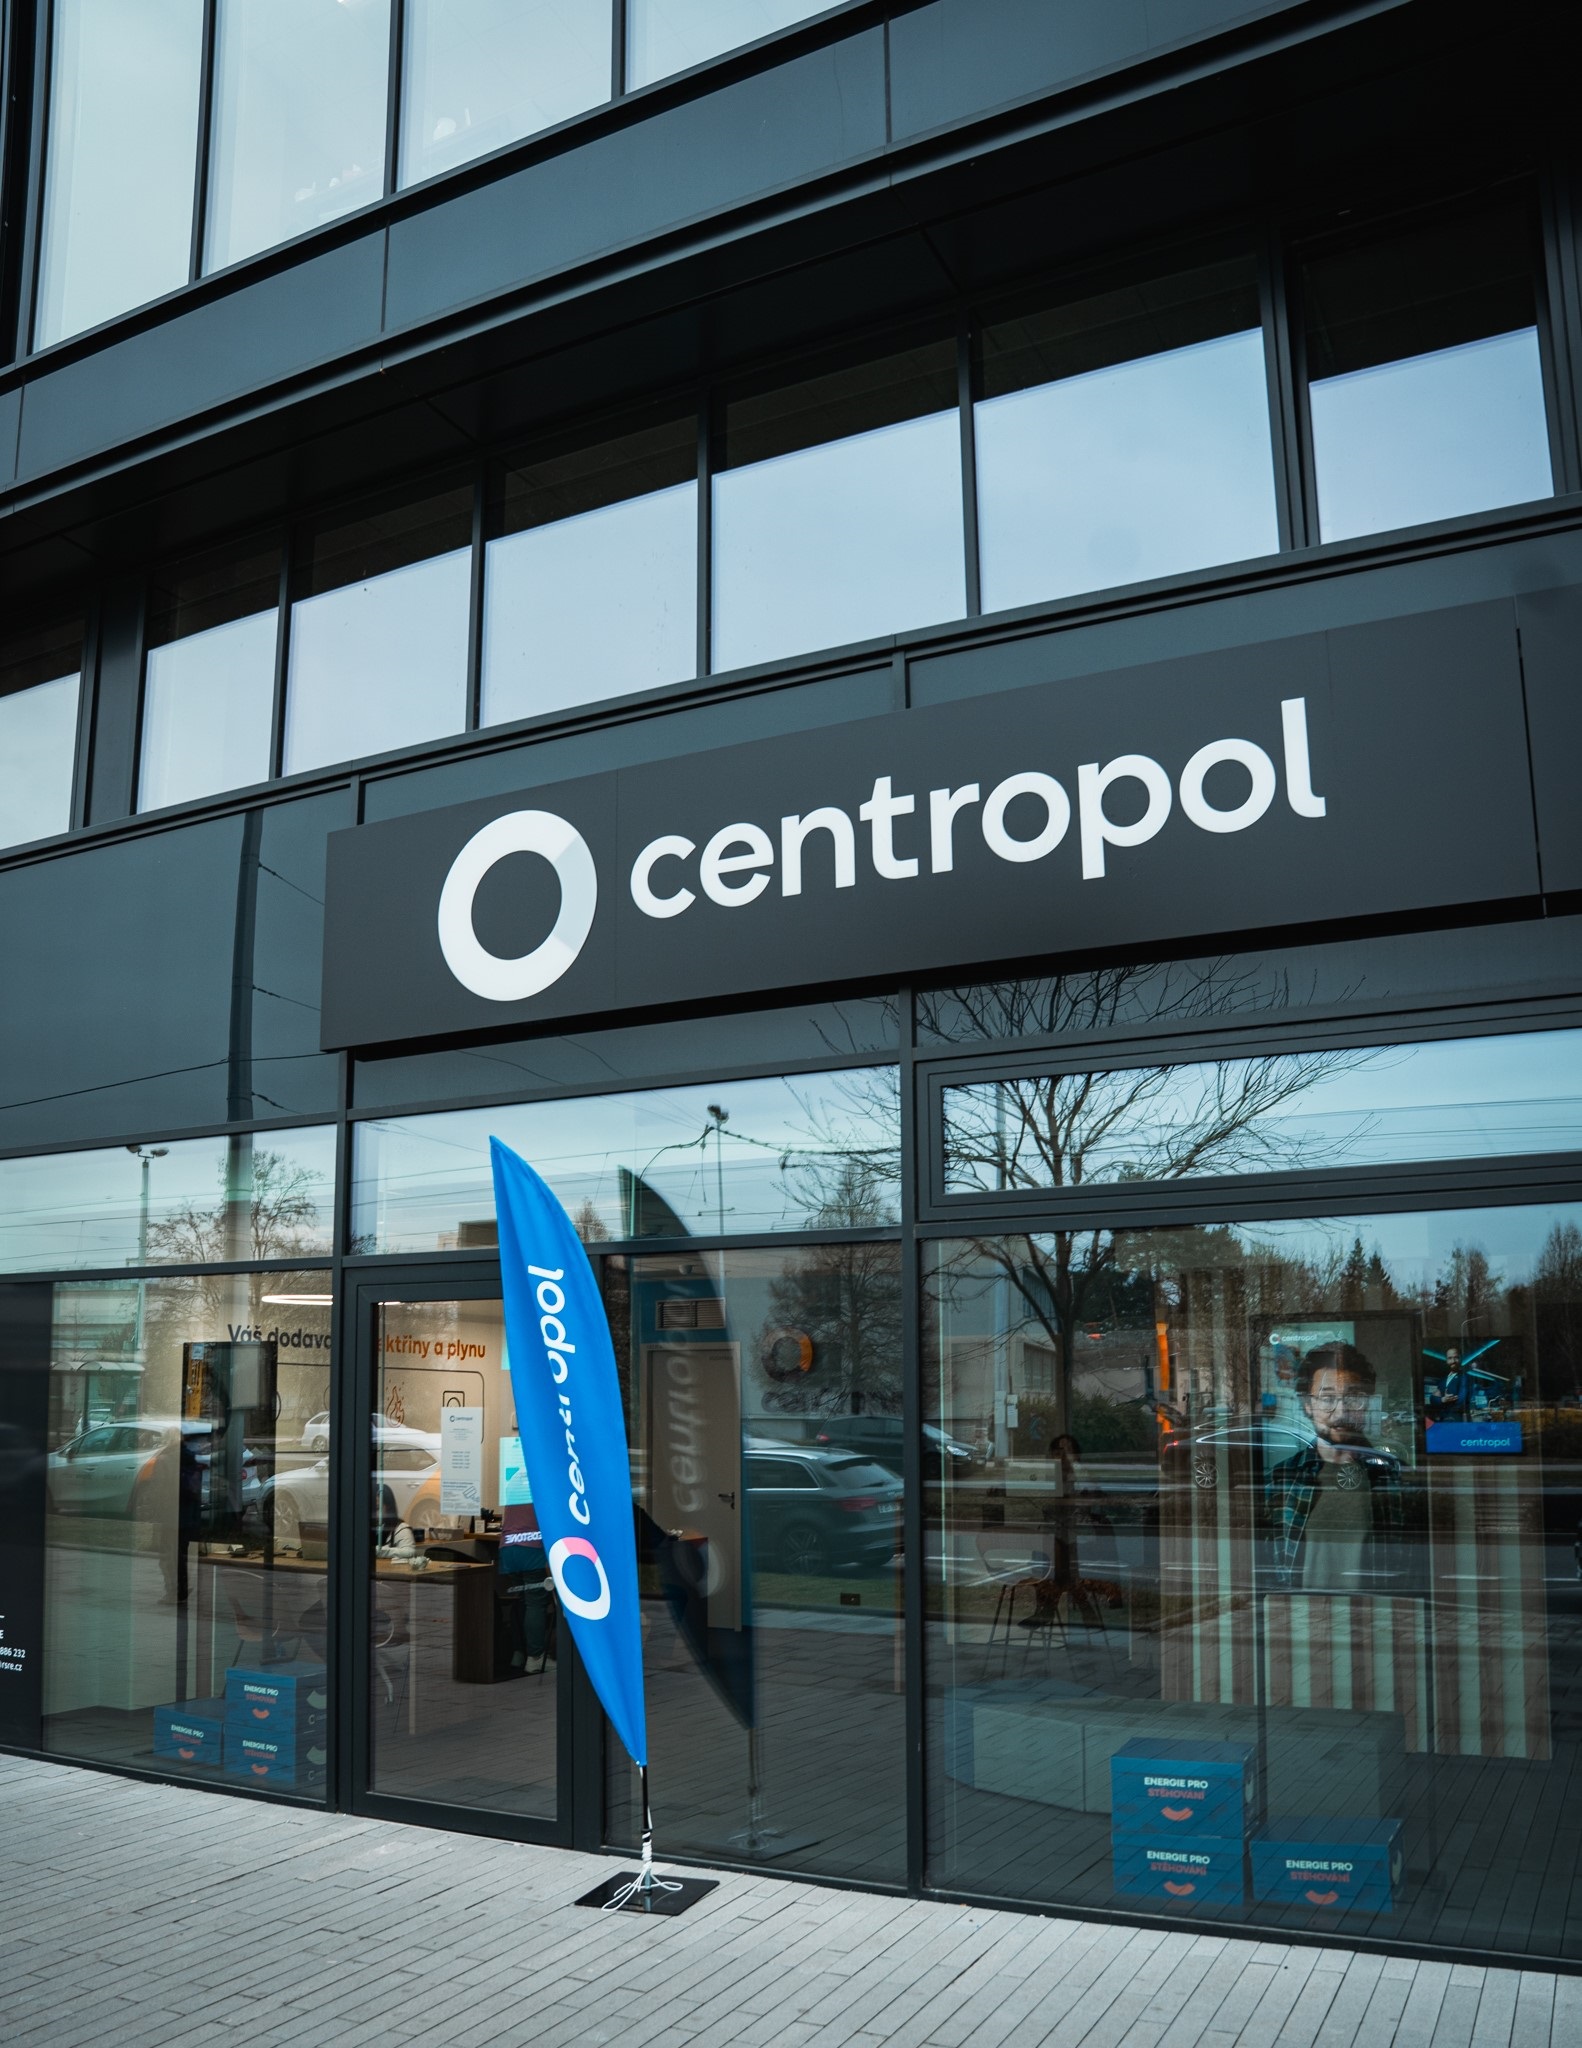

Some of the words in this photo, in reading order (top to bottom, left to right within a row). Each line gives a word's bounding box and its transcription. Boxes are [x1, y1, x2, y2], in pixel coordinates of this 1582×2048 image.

[630, 697, 1327, 919] centropol
[227, 1323, 263, 1342] Váš
[434, 1341, 443, 1355] a
[447, 1339, 486, 1361] plynu
[1460, 1438, 1511, 1448] centropol
[13, 1648, 26, 1658] 232
[267, 1687, 279, 1696] PRO
[1144, 1777, 1186, 1788] ENERGIE
[1187, 1780, 1209, 1789] PRO
[1146, 1850, 1188, 1862] ENERGIE
[1189, 1854, 1210, 1864] PRO
[1285, 1860, 1330, 1870] ENERGIE
[1331, 1862, 1353, 1871] PRO
